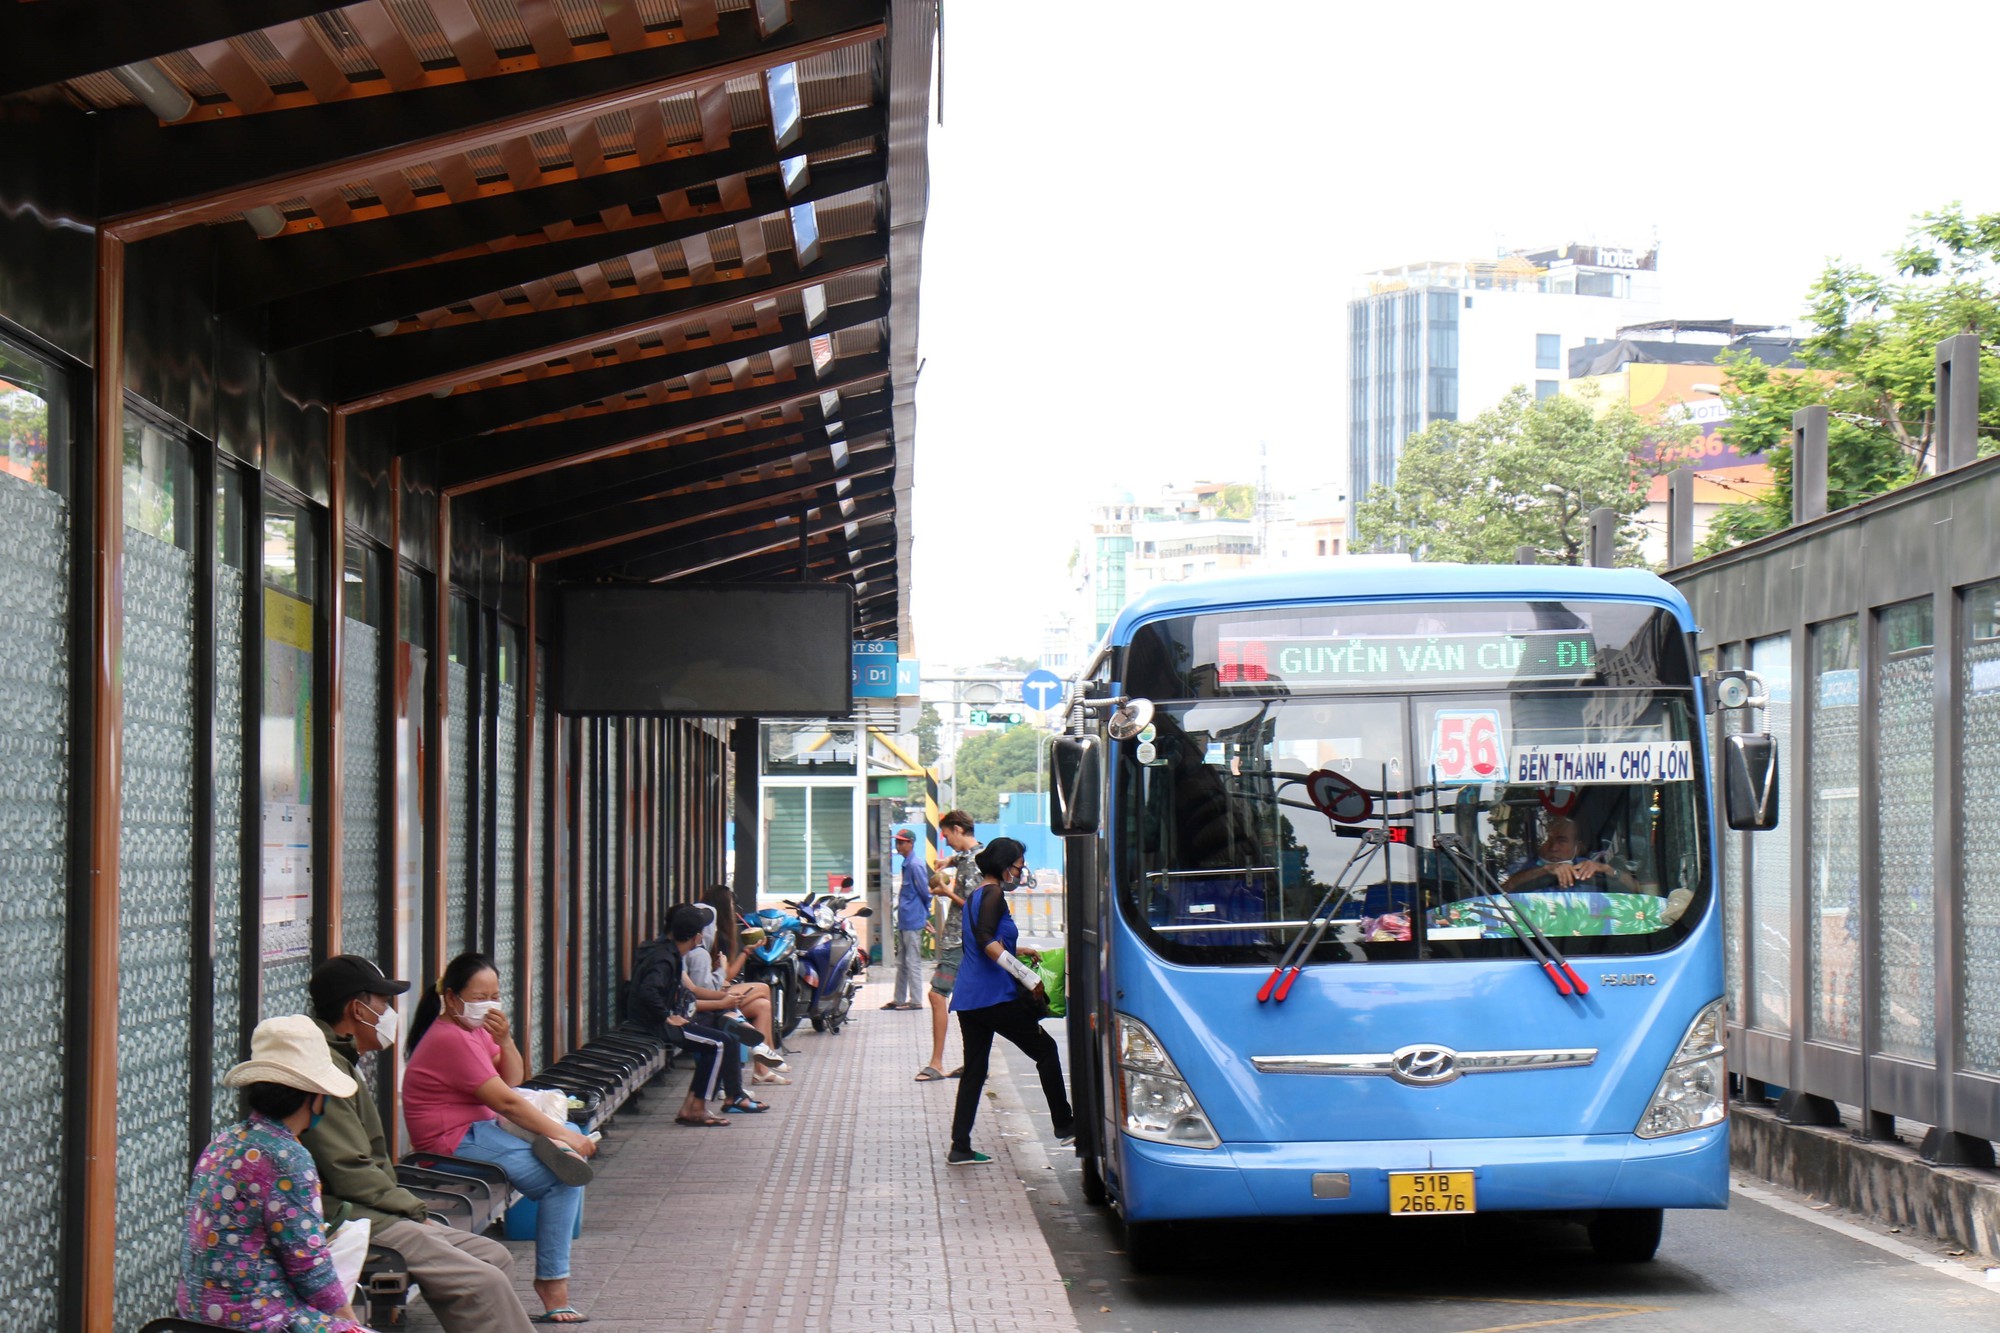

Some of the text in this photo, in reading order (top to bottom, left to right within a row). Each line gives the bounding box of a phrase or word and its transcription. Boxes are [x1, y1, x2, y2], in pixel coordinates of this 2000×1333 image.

[1597, 247, 1639, 269] hotel
[1655, 432, 1723, 463] 036
[1218, 640, 1269, 682] 56
[1397, 638, 1465, 671] VĂN
[870, 669, 886, 681] D1
[1438, 717, 1498, 777] 56
[1518, 745, 1550, 781] BẾN
[1554, 744, 1607, 781] THÀNH
[1620, 744, 1652, 782] CHỢ
[1659, 742, 1689, 779] LỚN
[1413, 1175, 1449, 1192] 51B
[1400, 1194, 1465, 1212] 266.76
